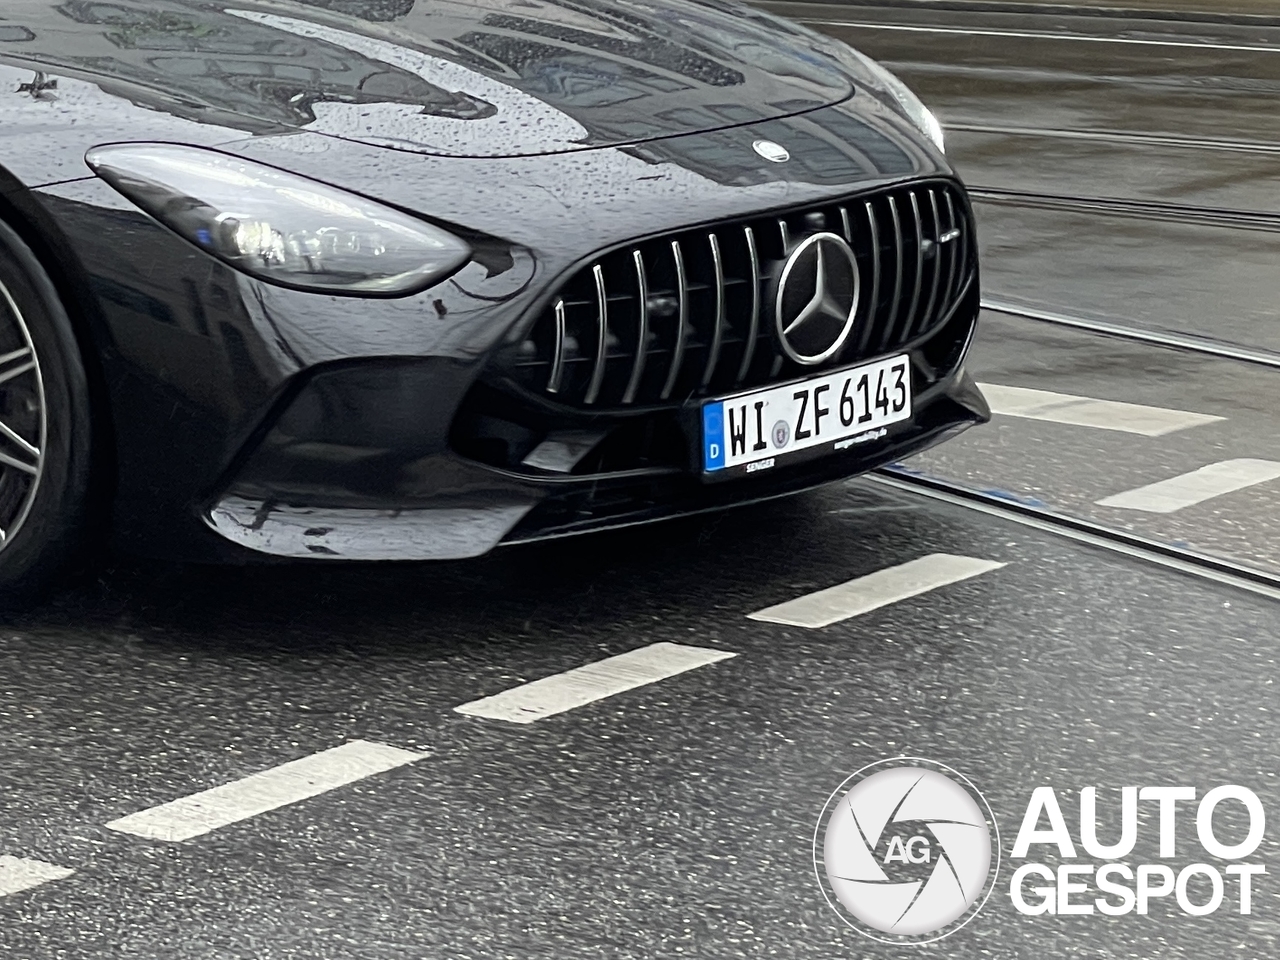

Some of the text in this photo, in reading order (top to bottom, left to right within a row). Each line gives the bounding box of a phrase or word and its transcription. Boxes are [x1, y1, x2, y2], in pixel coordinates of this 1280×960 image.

[728, 401, 767, 457] WI
[793, 384, 830, 441] ZF
[839, 363, 906, 427] 6143
[710, 444, 719, 459] D
